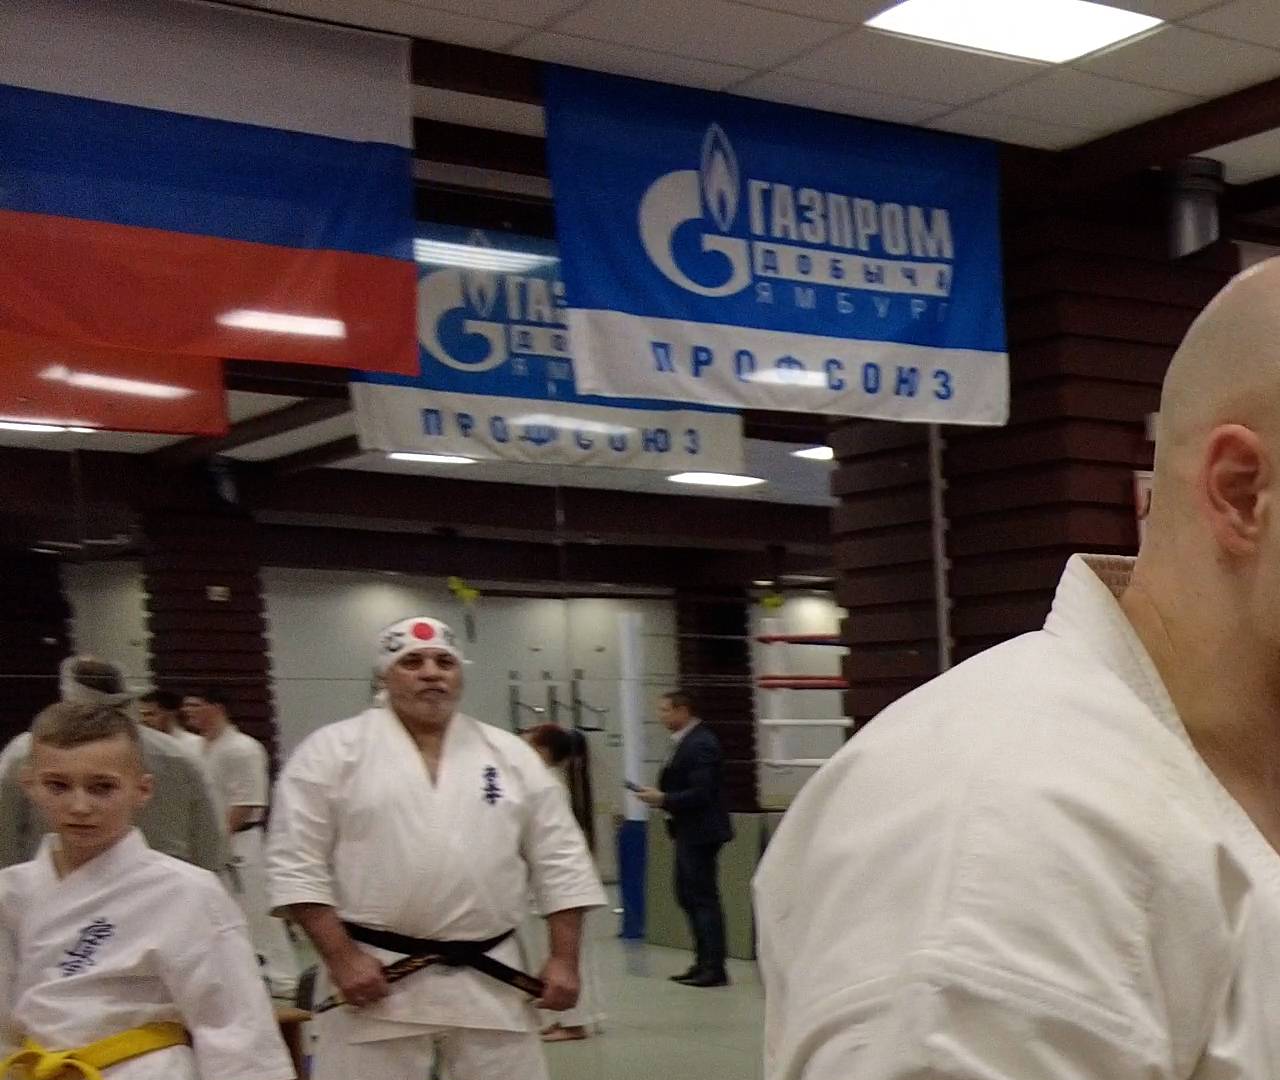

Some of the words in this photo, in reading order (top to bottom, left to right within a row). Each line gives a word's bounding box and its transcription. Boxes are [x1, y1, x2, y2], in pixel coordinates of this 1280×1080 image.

[747, 178, 955, 260] ГАЗПРОМ
[762, 248, 950, 292] ДОБЫЧА
[755, 281, 950, 323] ЯМБУРГ
